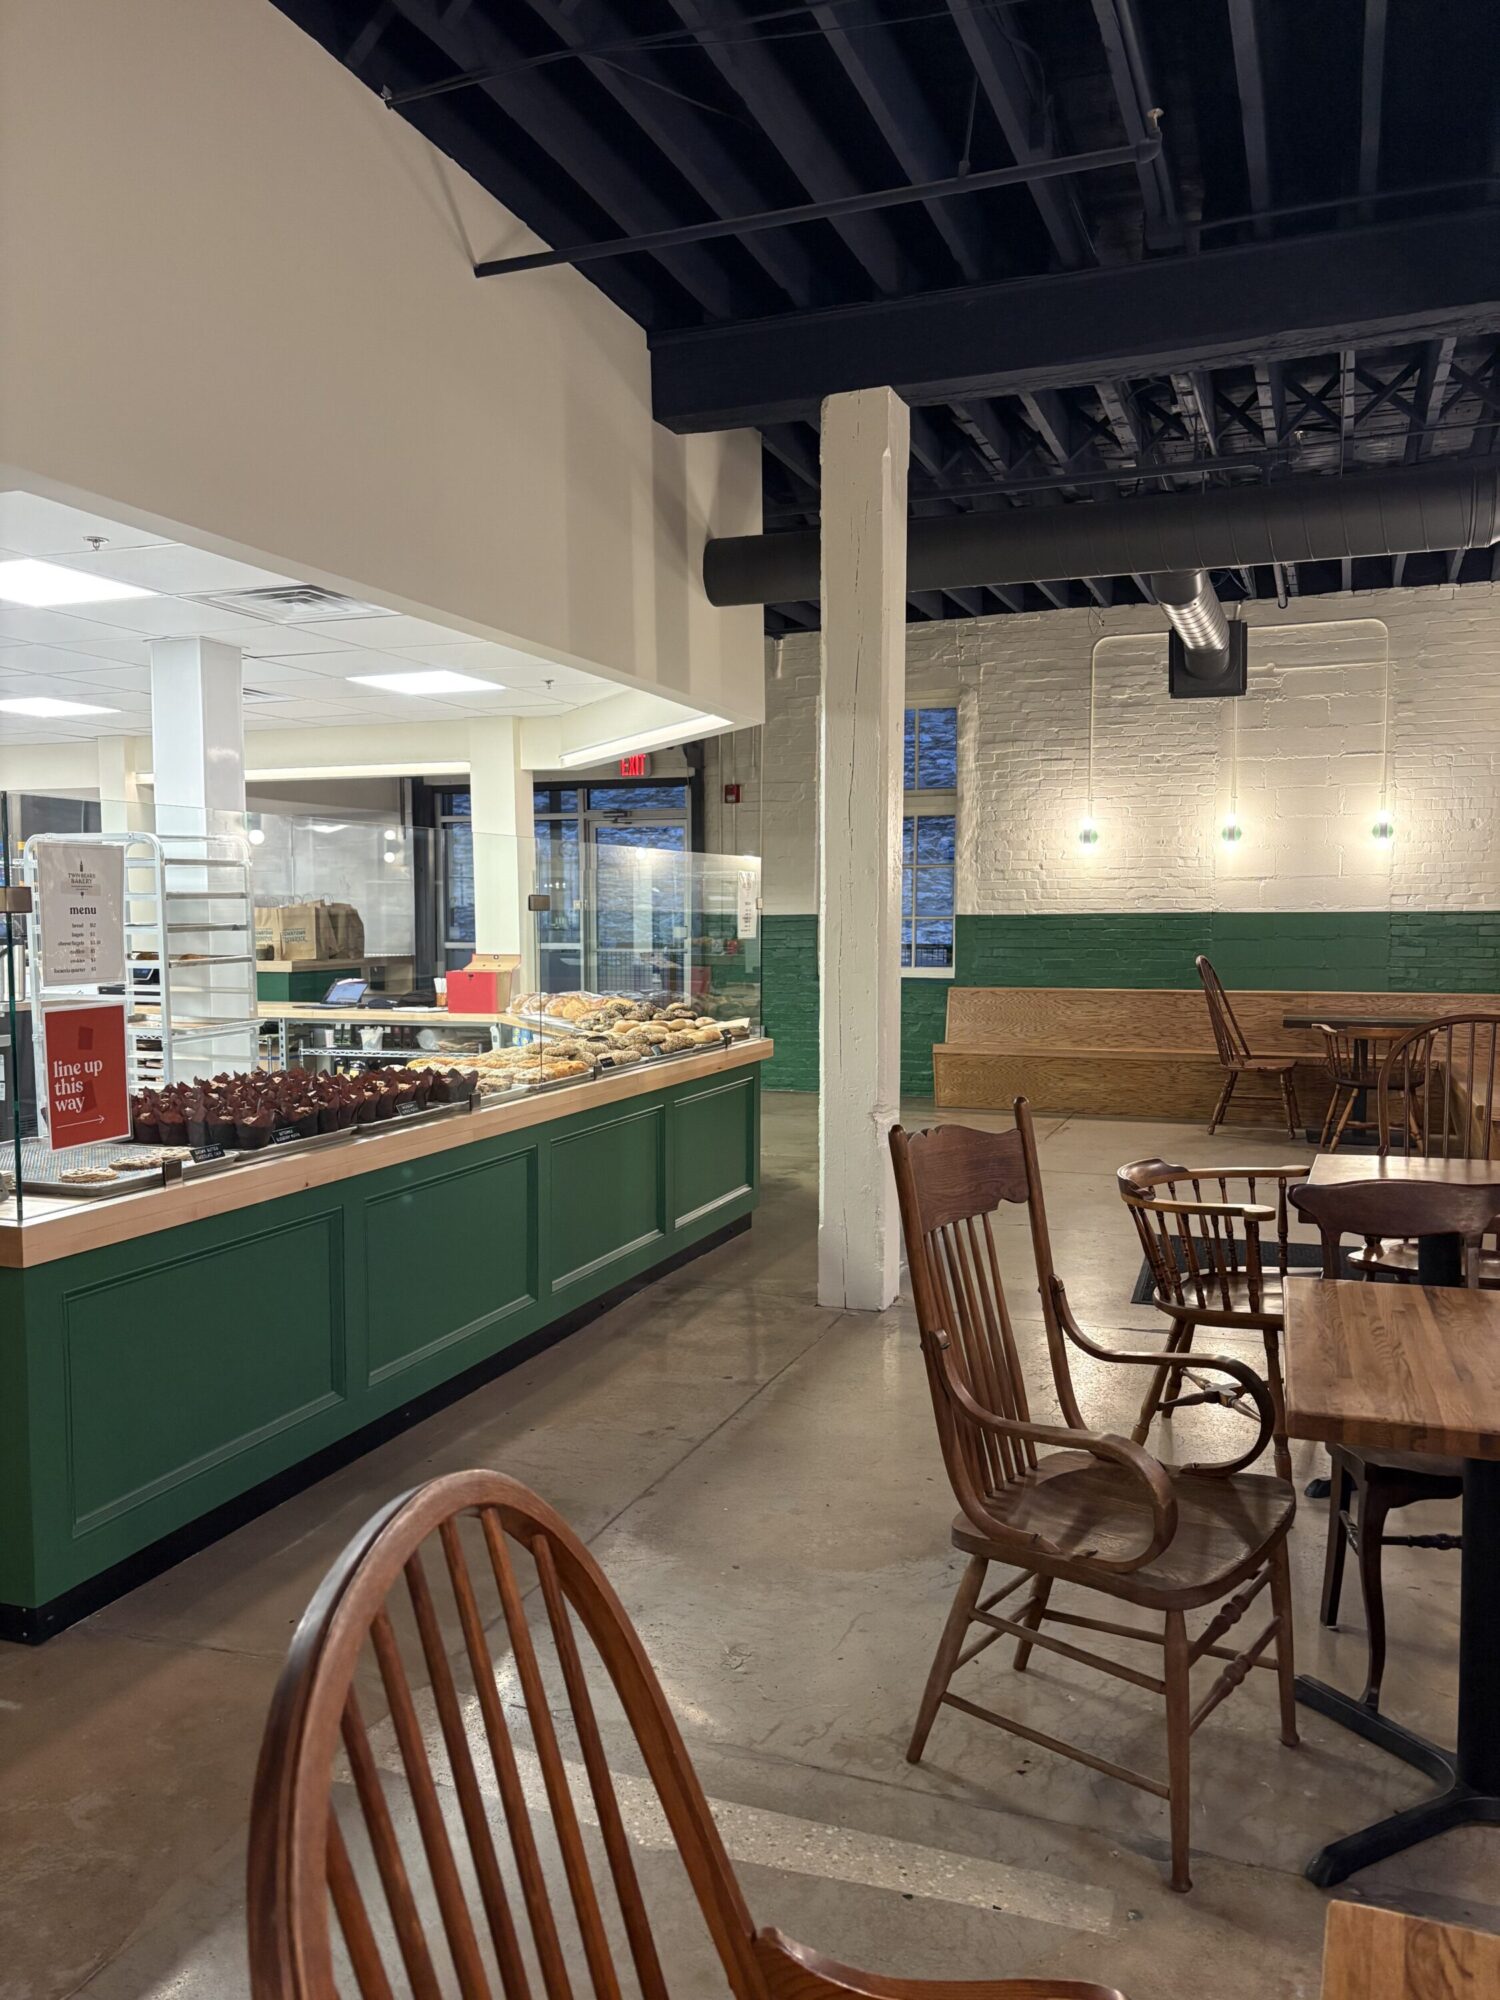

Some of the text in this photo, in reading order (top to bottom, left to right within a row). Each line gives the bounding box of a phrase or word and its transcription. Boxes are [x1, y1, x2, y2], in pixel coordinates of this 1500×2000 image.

[621, 753, 646, 777] EXIT
[69, 906, 97, 915] menu
[53, 1060, 103, 1078] line up
[54, 1077, 84, 1096] this
[55, 1097, 85, 1114] way
